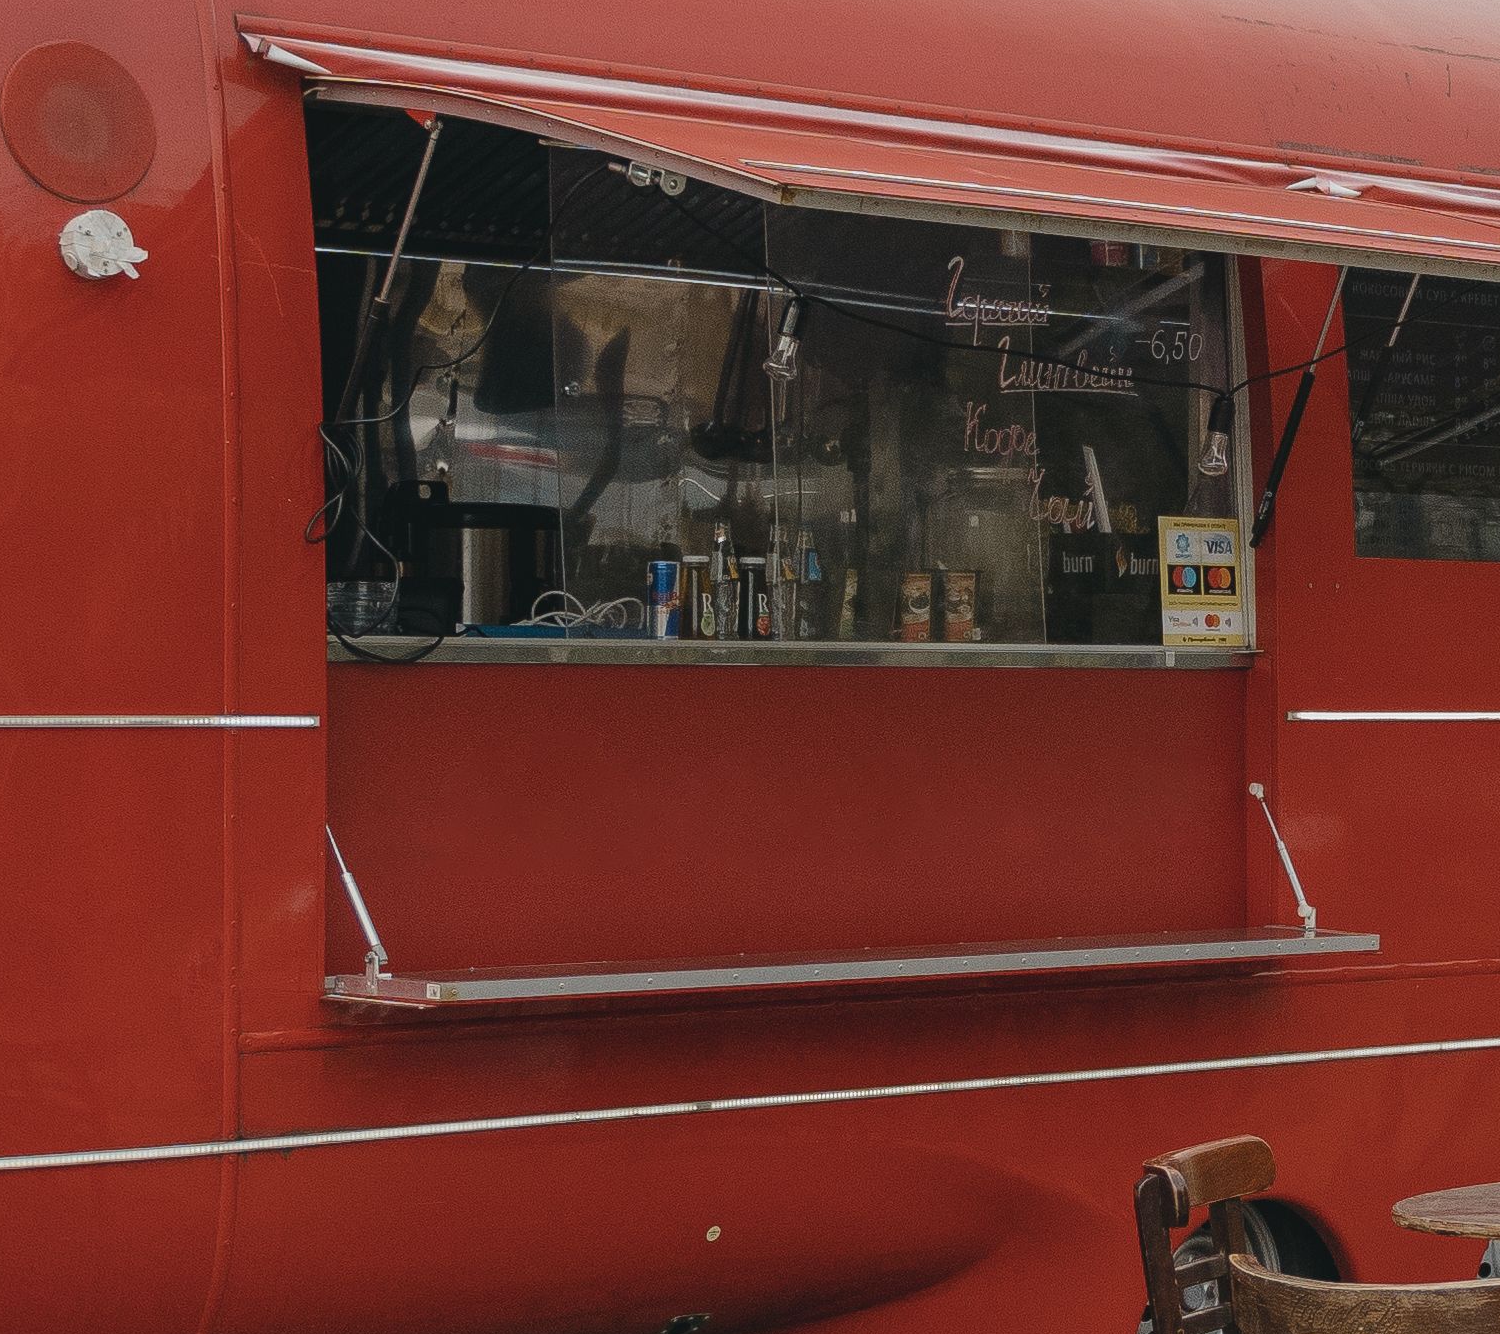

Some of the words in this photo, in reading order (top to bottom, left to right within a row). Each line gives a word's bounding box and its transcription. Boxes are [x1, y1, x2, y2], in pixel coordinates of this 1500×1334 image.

[1204, 540, 1233, 555] VISA
[1063, 552, 1093, 573] burn
[1130, 553, 1159, 575] burn
